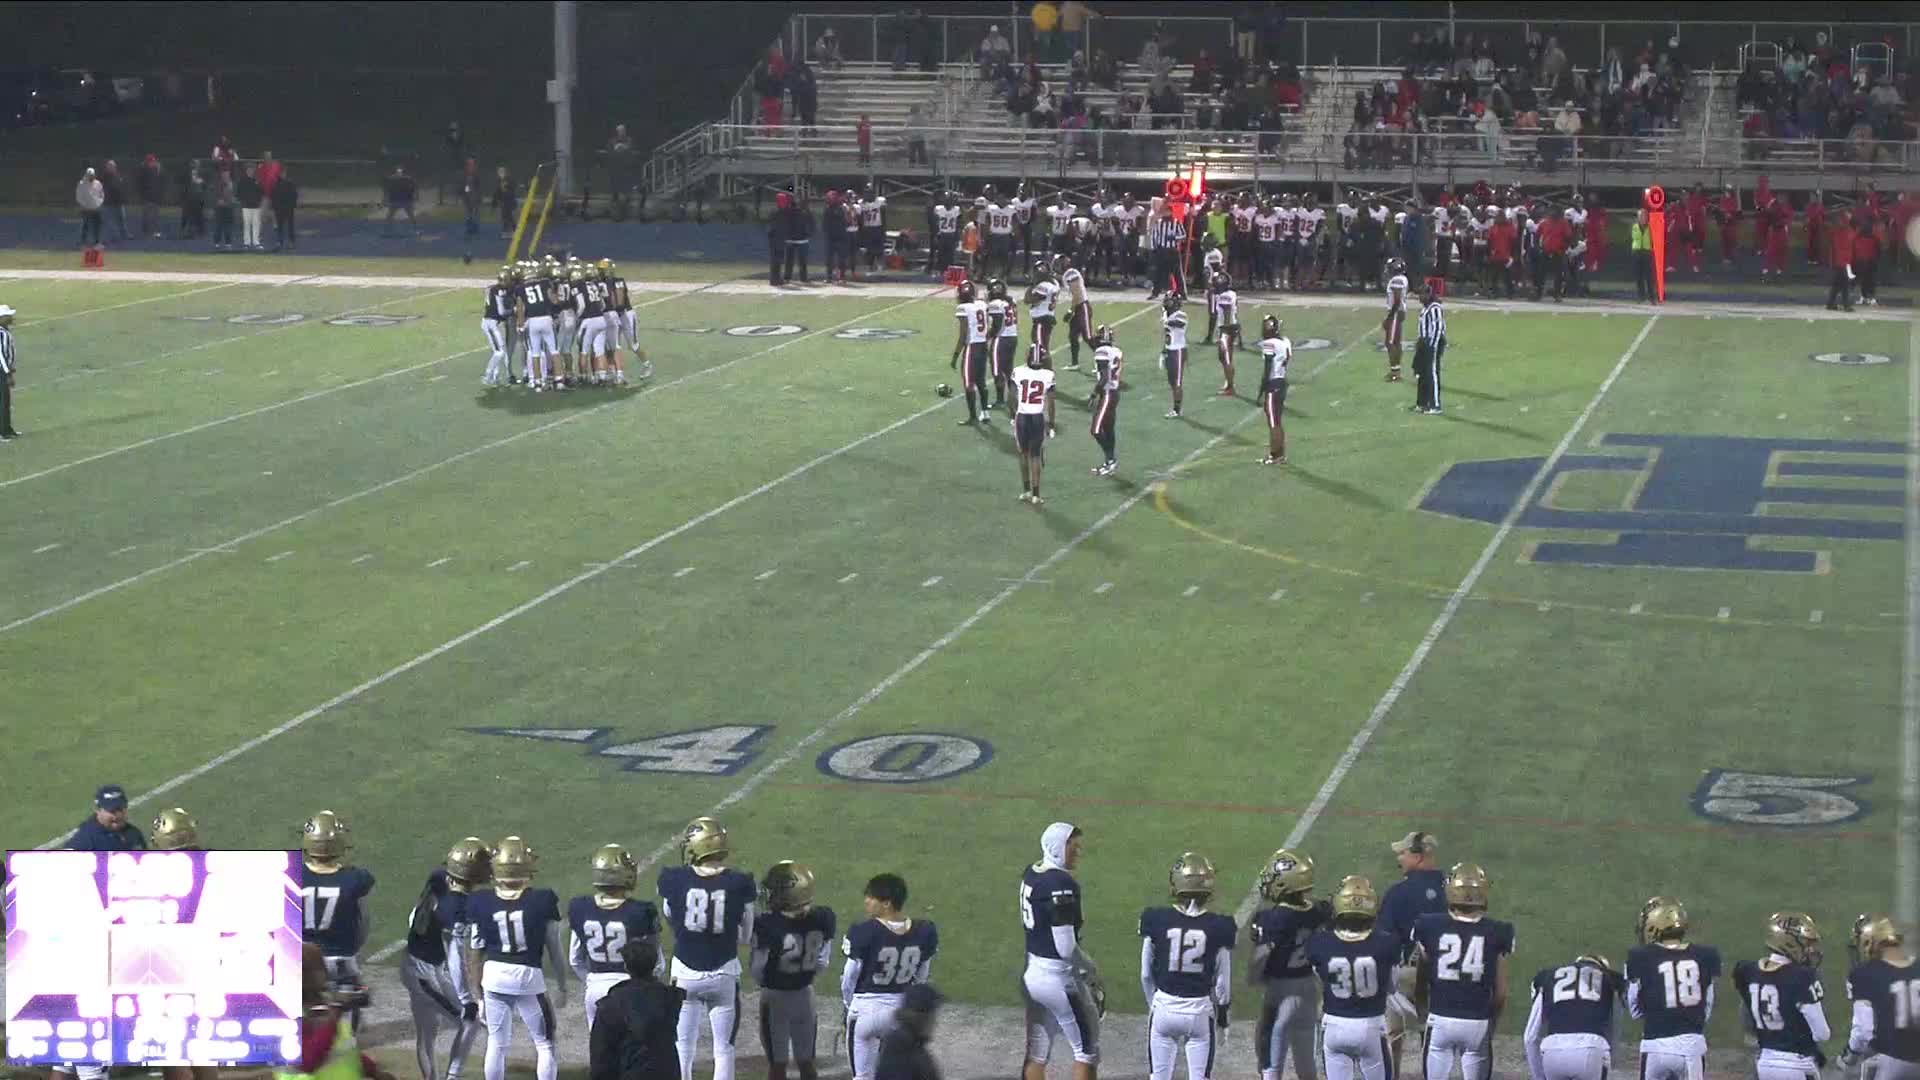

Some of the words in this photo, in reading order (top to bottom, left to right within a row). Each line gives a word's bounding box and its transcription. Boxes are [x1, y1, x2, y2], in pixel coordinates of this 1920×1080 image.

[525, 285, 544, 304] 51
[975, 309, 986, 332] 9
[1019, 379, 1045, 404] 12
[302, 886, 340, 930] 17
[684, 887, 726, 934] 81
[492, 910, 528, 953] 11
[583, 919, 627, 964] 22
[1167, 927, 1207, 973] 12
[1327, 955, 1379, 999] 30
[1437, 932, 1486, 982] 24
[1552, 966, 1604, 1002] 20
[1657, 959, 1702, 1009] 18
[1808, 979, 1824, 1001] 13
[1749, 982, 1785, 1031] 13
